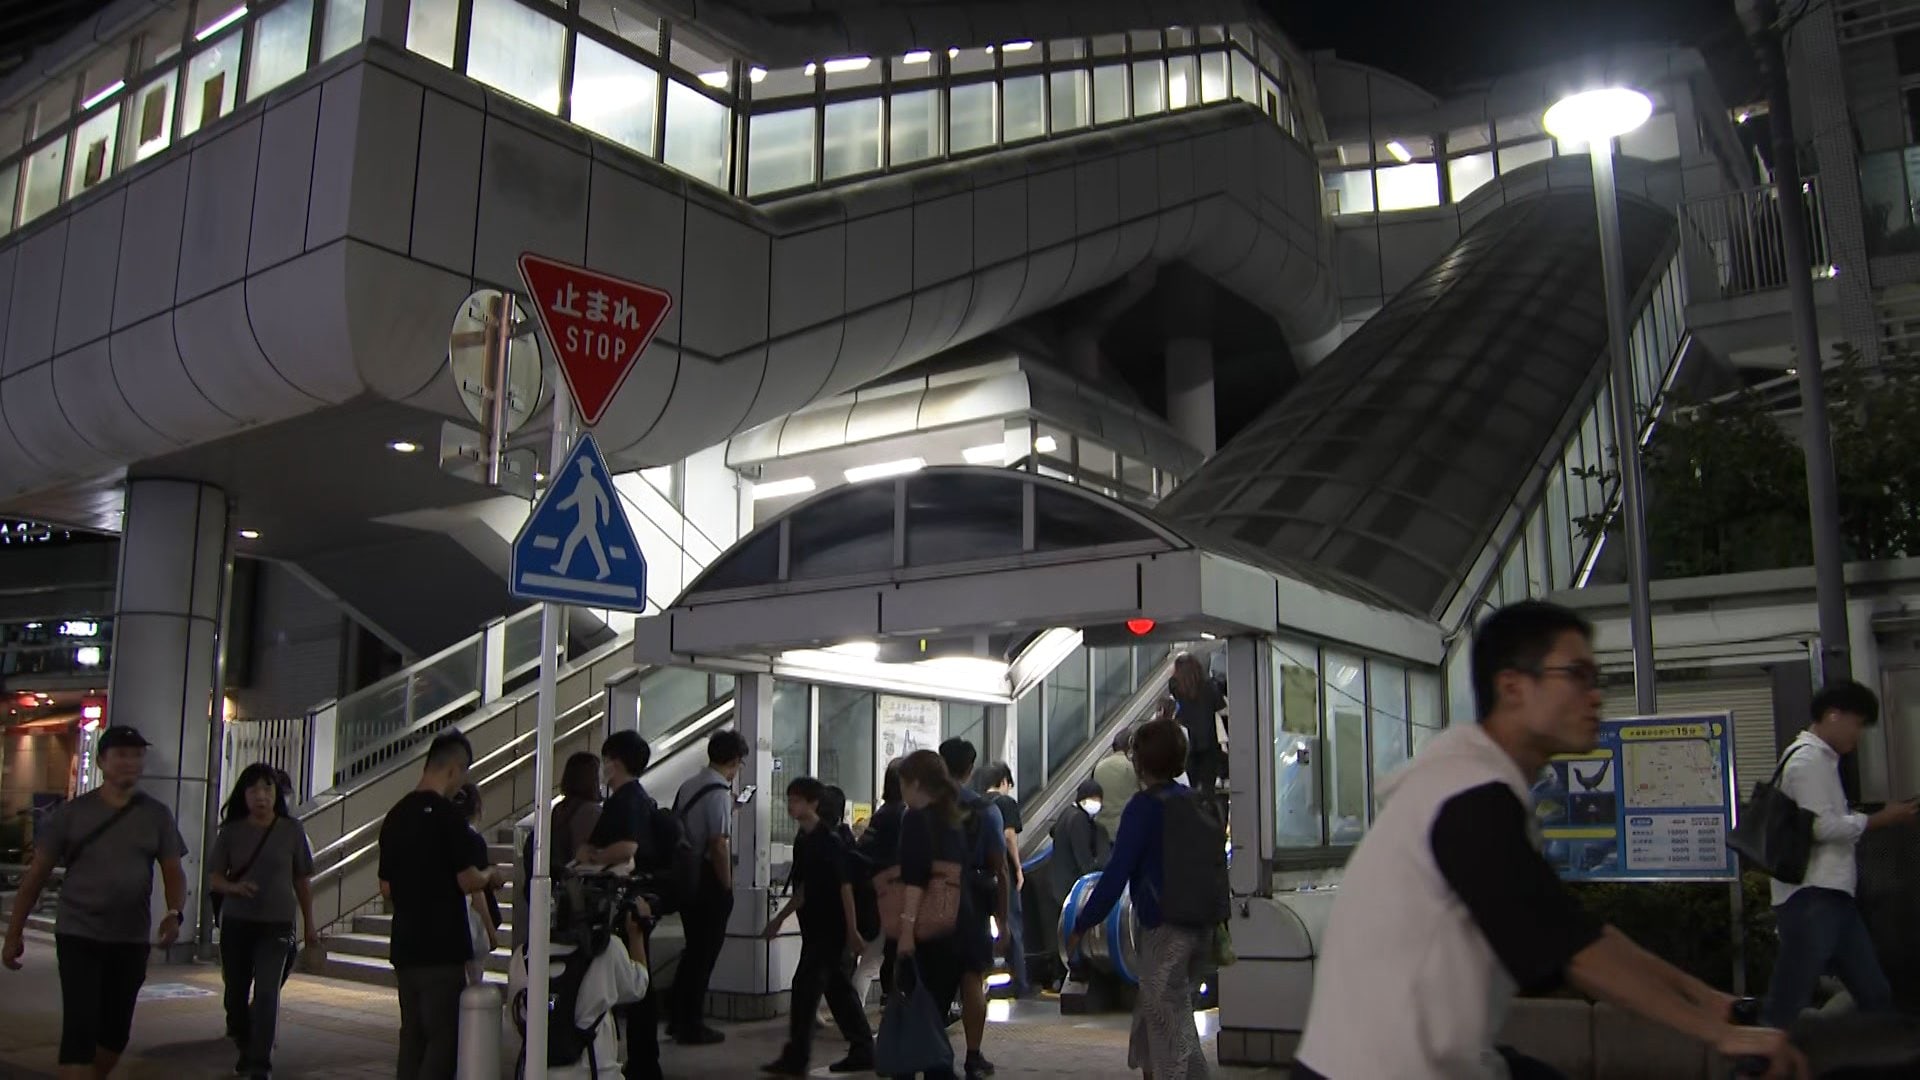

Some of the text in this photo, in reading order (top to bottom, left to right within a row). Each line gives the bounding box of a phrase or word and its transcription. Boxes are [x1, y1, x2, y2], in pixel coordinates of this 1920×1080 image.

[551, 281, 641, 331] 止まれ
[565, 327, 627, 364] STOP
